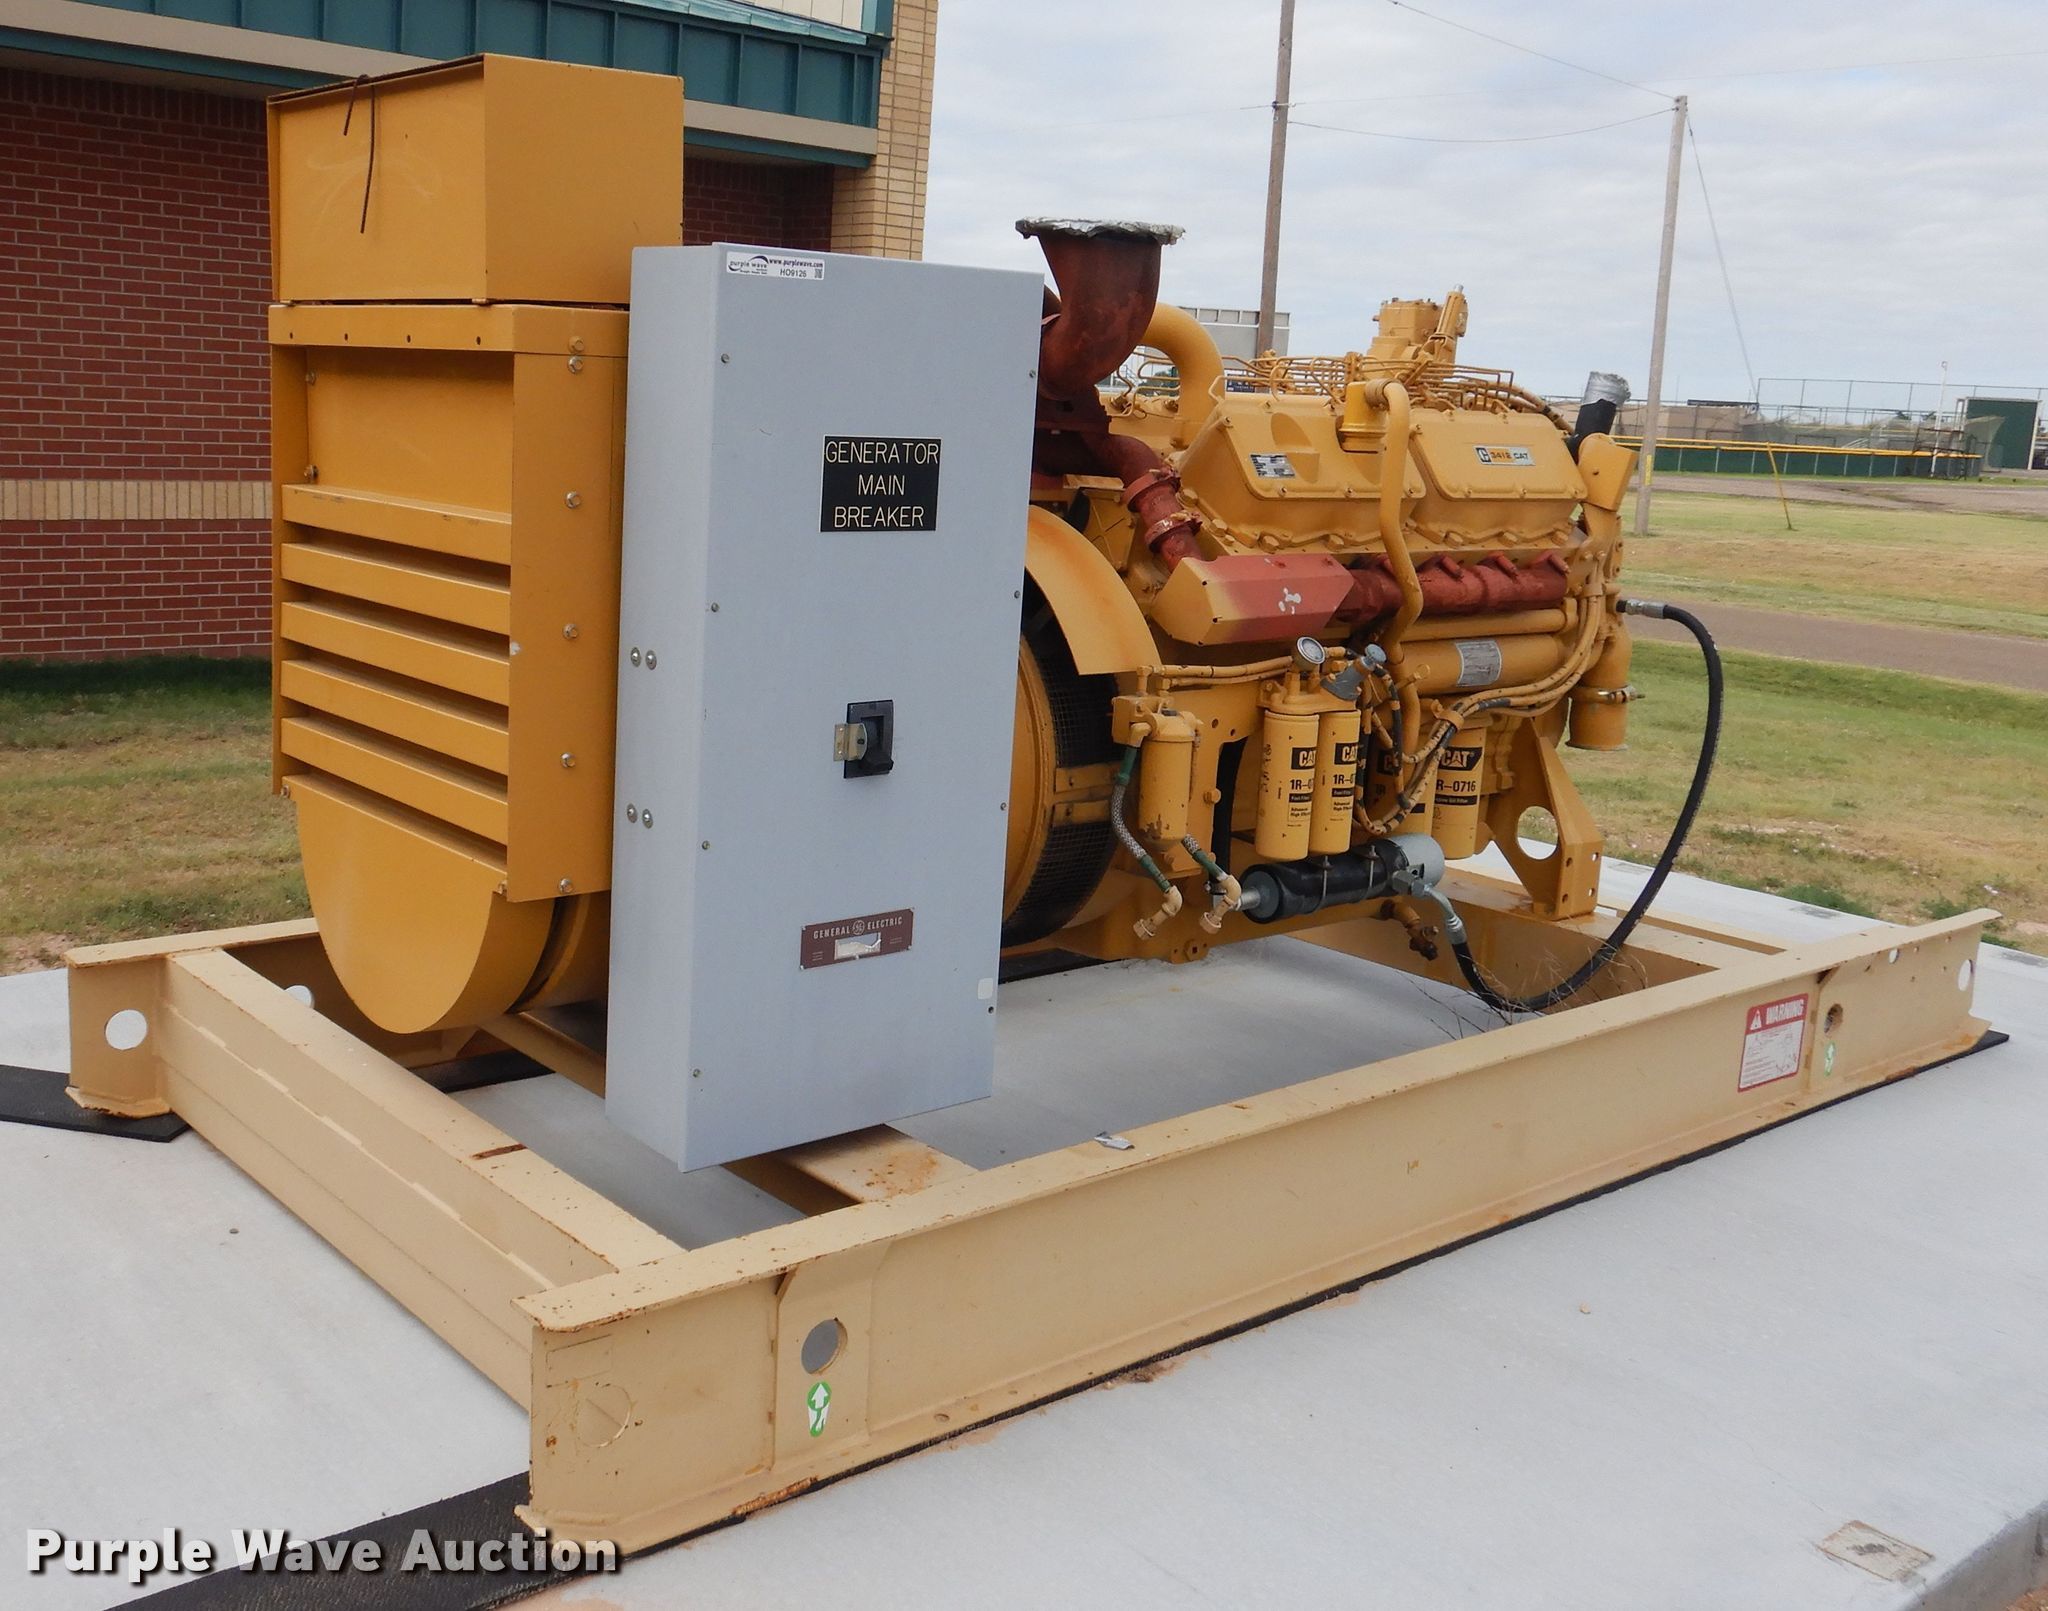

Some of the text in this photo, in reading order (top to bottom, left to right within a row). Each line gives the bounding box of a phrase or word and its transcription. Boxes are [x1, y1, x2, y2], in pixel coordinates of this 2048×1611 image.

[730, 260, 750, 269] purple
[769, 258, 823, 268] www.purplewave.com
[825, 441, 939, 465] GENERATOR
[1513, 452, 1529, 460] CAT
[858, 474, 905, 496] MAIN
[834, 506, 924, 528] BREAKER
[1436, 778, 1477, 792] R-0716
[813, 926, 850, 940] GENERAL
[867, 916, 902, 930] ELECTRIC
[1766, 999, 1804, 1025] WARNING
